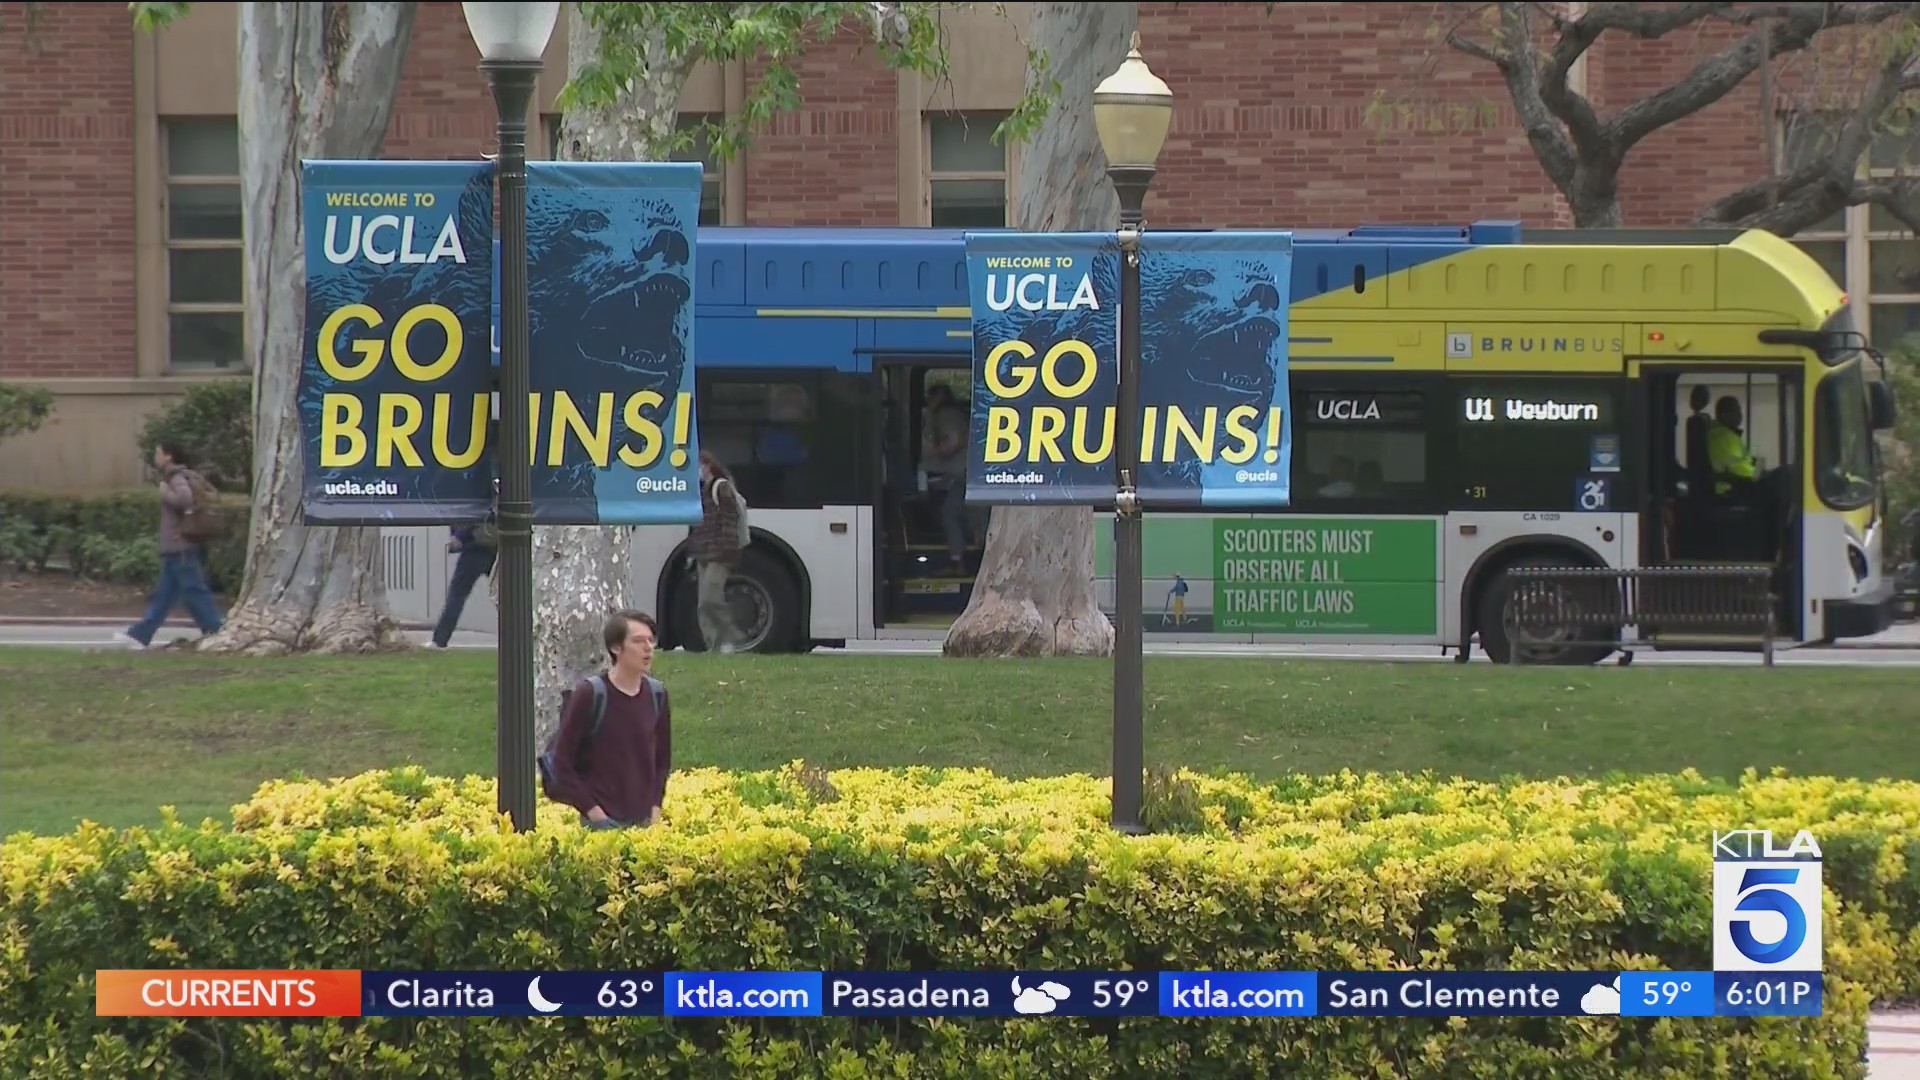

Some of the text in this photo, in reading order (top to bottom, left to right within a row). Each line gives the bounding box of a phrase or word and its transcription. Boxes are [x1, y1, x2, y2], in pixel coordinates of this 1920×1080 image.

[326, 192, 435, 208] WELCOME TO
[323, 214, 467, 265] UCLA
[986, 257, 1073, 268] WELCOME TO
[986, 273, 1100, 312] UCLA
[316, 303, 464, 382] GO
[984, 339, 1098, 398] GO
[1317, 400, 1381, 420] UCLA
[1465, 398, 1599, 421] U1 Weyburn
[984, 405, 1282, 464] BRUINS!
[325, 481, 398, 496] ucla.edu
[636, 478, 688, 493] @ucla
[985, 472, 1044, 484] ucla.edu
[1235, 470, 1278, 484] @ucla
[1523, 513, 1537, 521] CA
[1223, 529, 1373, 554] SCOOTERS MUST
[1223, 559, 1344, 584] OBSERVE ALL
[1223, 589, 1354, 614] TRAFFIC LAWS
